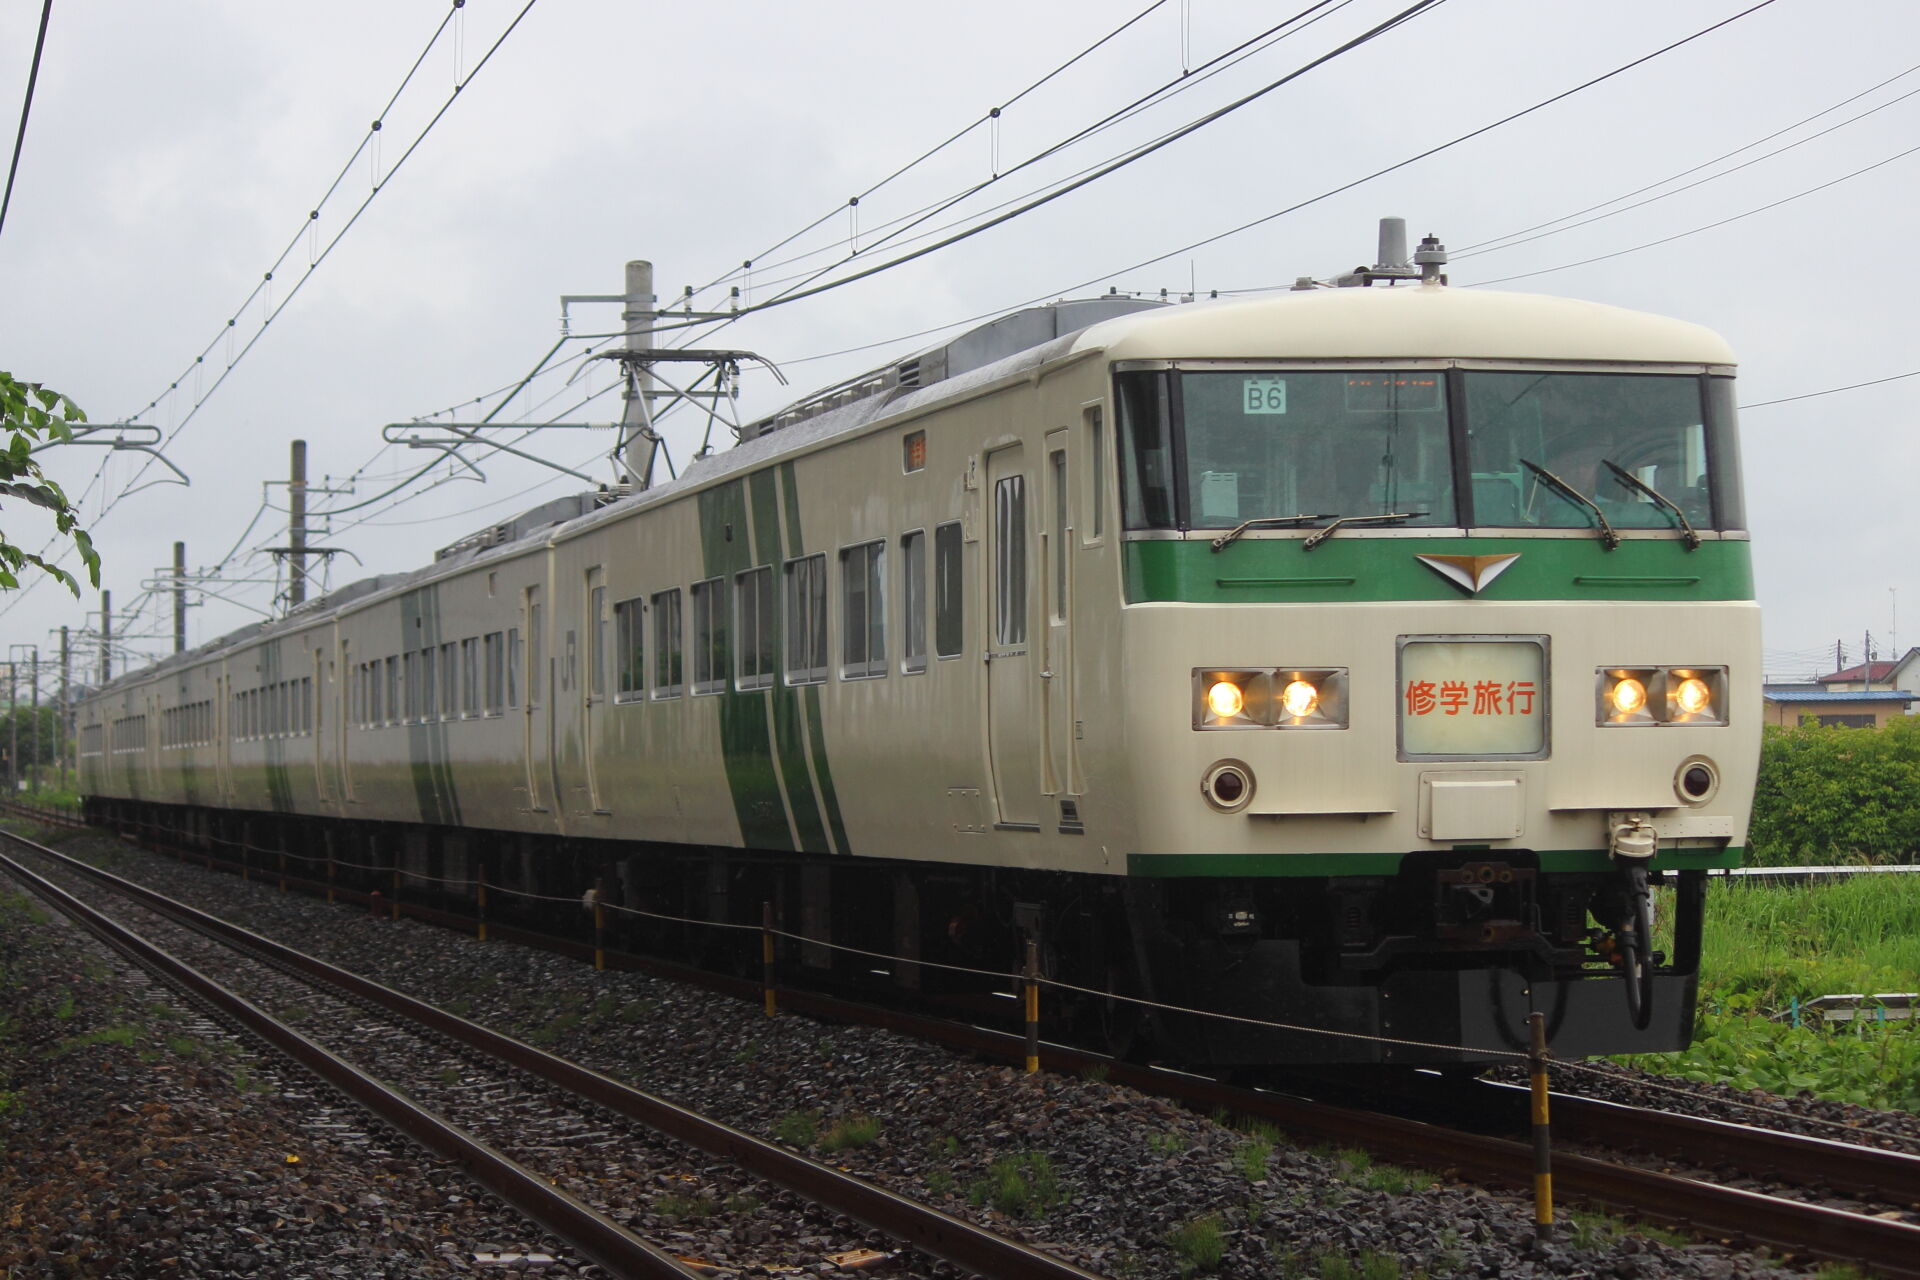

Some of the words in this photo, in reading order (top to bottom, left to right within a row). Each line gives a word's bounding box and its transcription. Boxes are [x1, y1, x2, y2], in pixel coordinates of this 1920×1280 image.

[1248, 387, 1281, 410] B6
[561, 630, 576, 692] JR
[1405, 680, 1536, 716] 修学旅行
